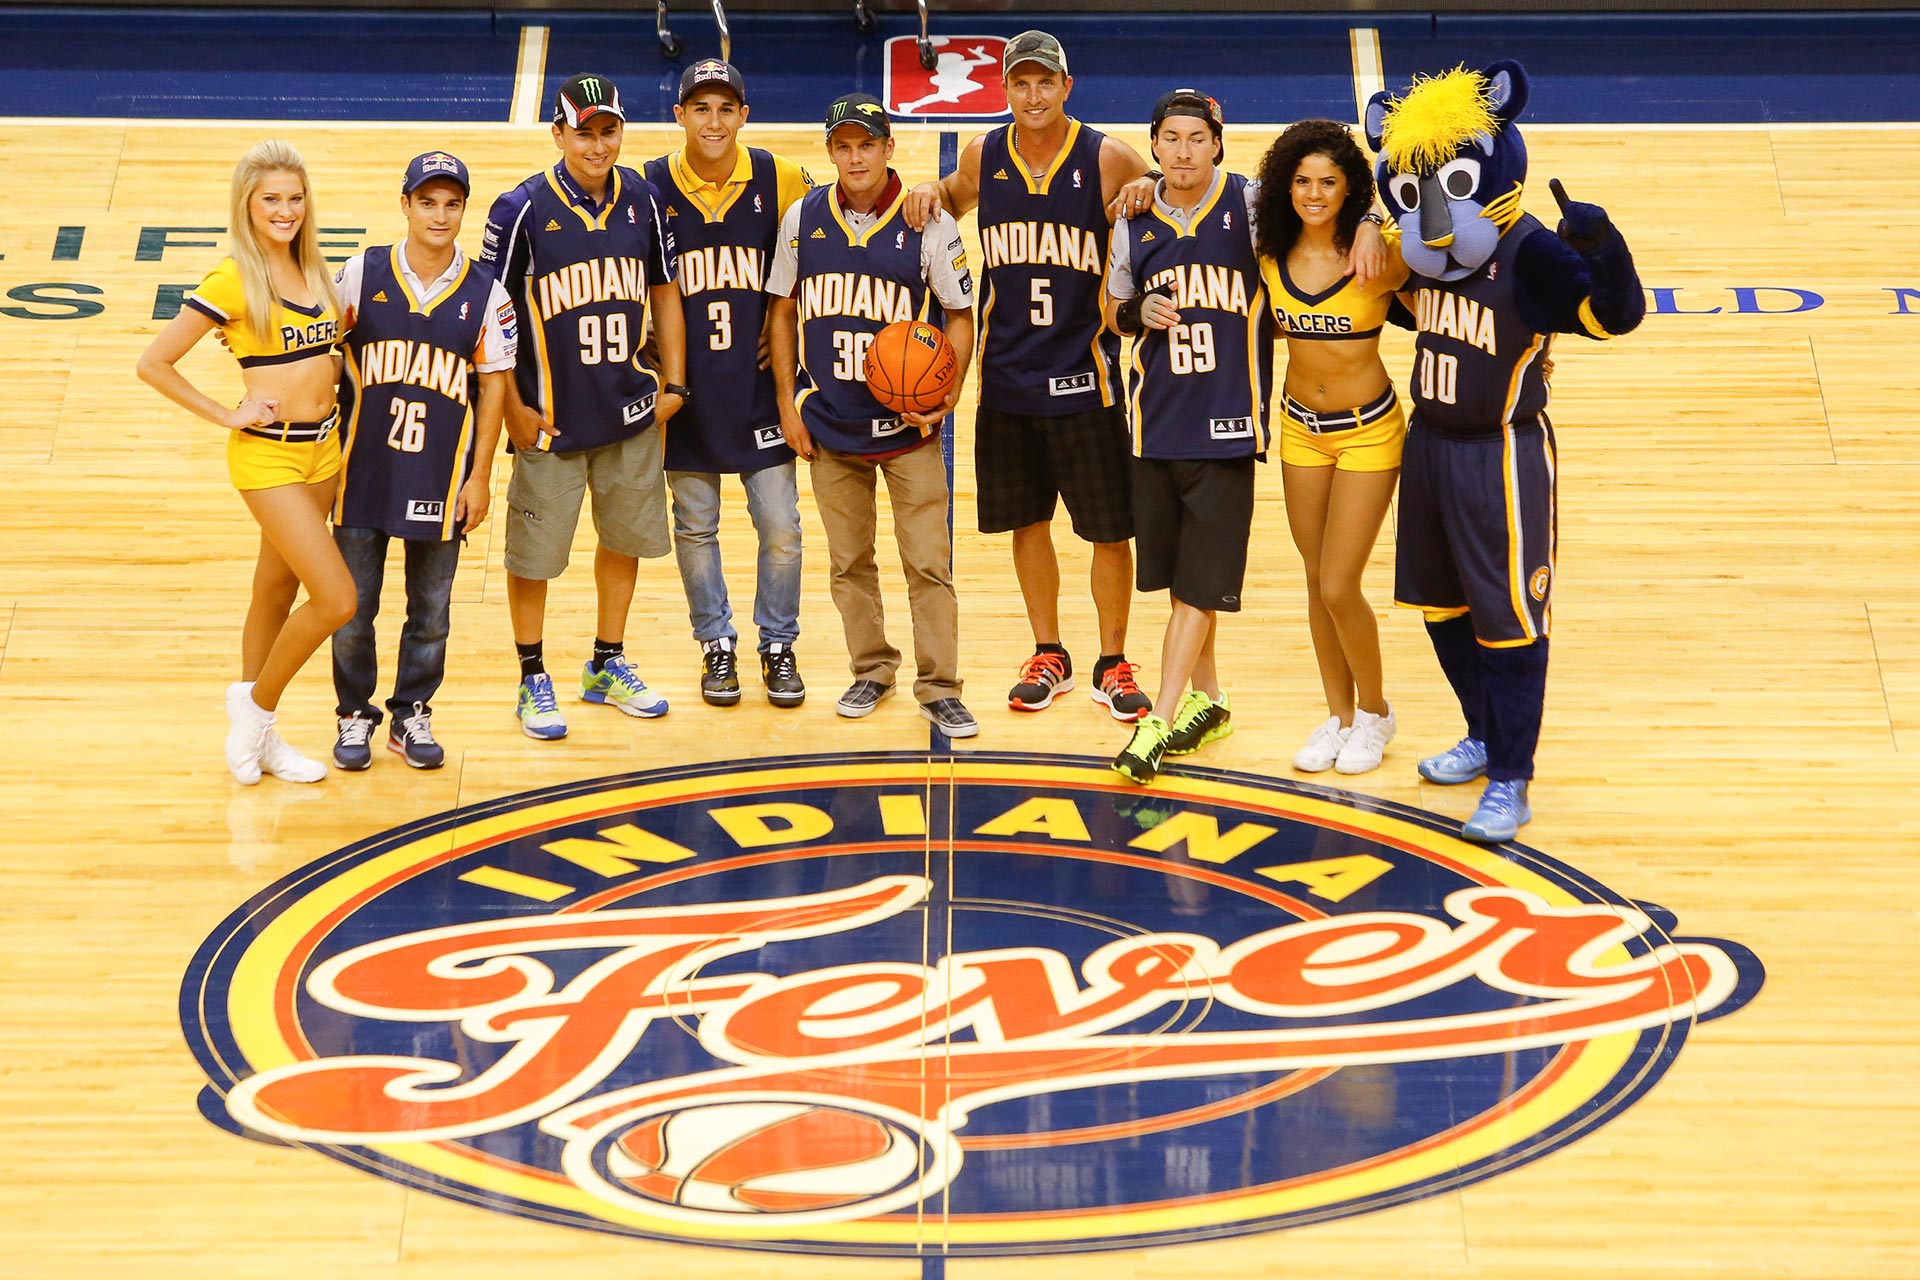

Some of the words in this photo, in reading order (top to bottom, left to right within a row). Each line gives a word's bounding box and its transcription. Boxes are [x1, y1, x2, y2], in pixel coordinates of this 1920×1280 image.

[422, 162, 440, 173] Red
[441, 163, 458, 174] Bull
[677, 245, 765, 297] DIAN
[982, 221, 1102, 276] INDIANA
[539, 256, 646, 322] INDIANA
[801, 272, 913, 325] INDIANA
[1030, 278, 1053, 326] 5
[578, 312, 628, 365] 99
[708, 301, 732, 350] 3
[1275, 307, 1352, 333] PACERS
[362, 339, 468, 406] INDIANA
[1168, 322, 1216, 375] 69
[1421, 347, 1458, 405] 00
[387, 396, 427, 453] 26
[458, 795, 1395, 902] INDIANA
[226, 875, 1738, 1143] Fever
